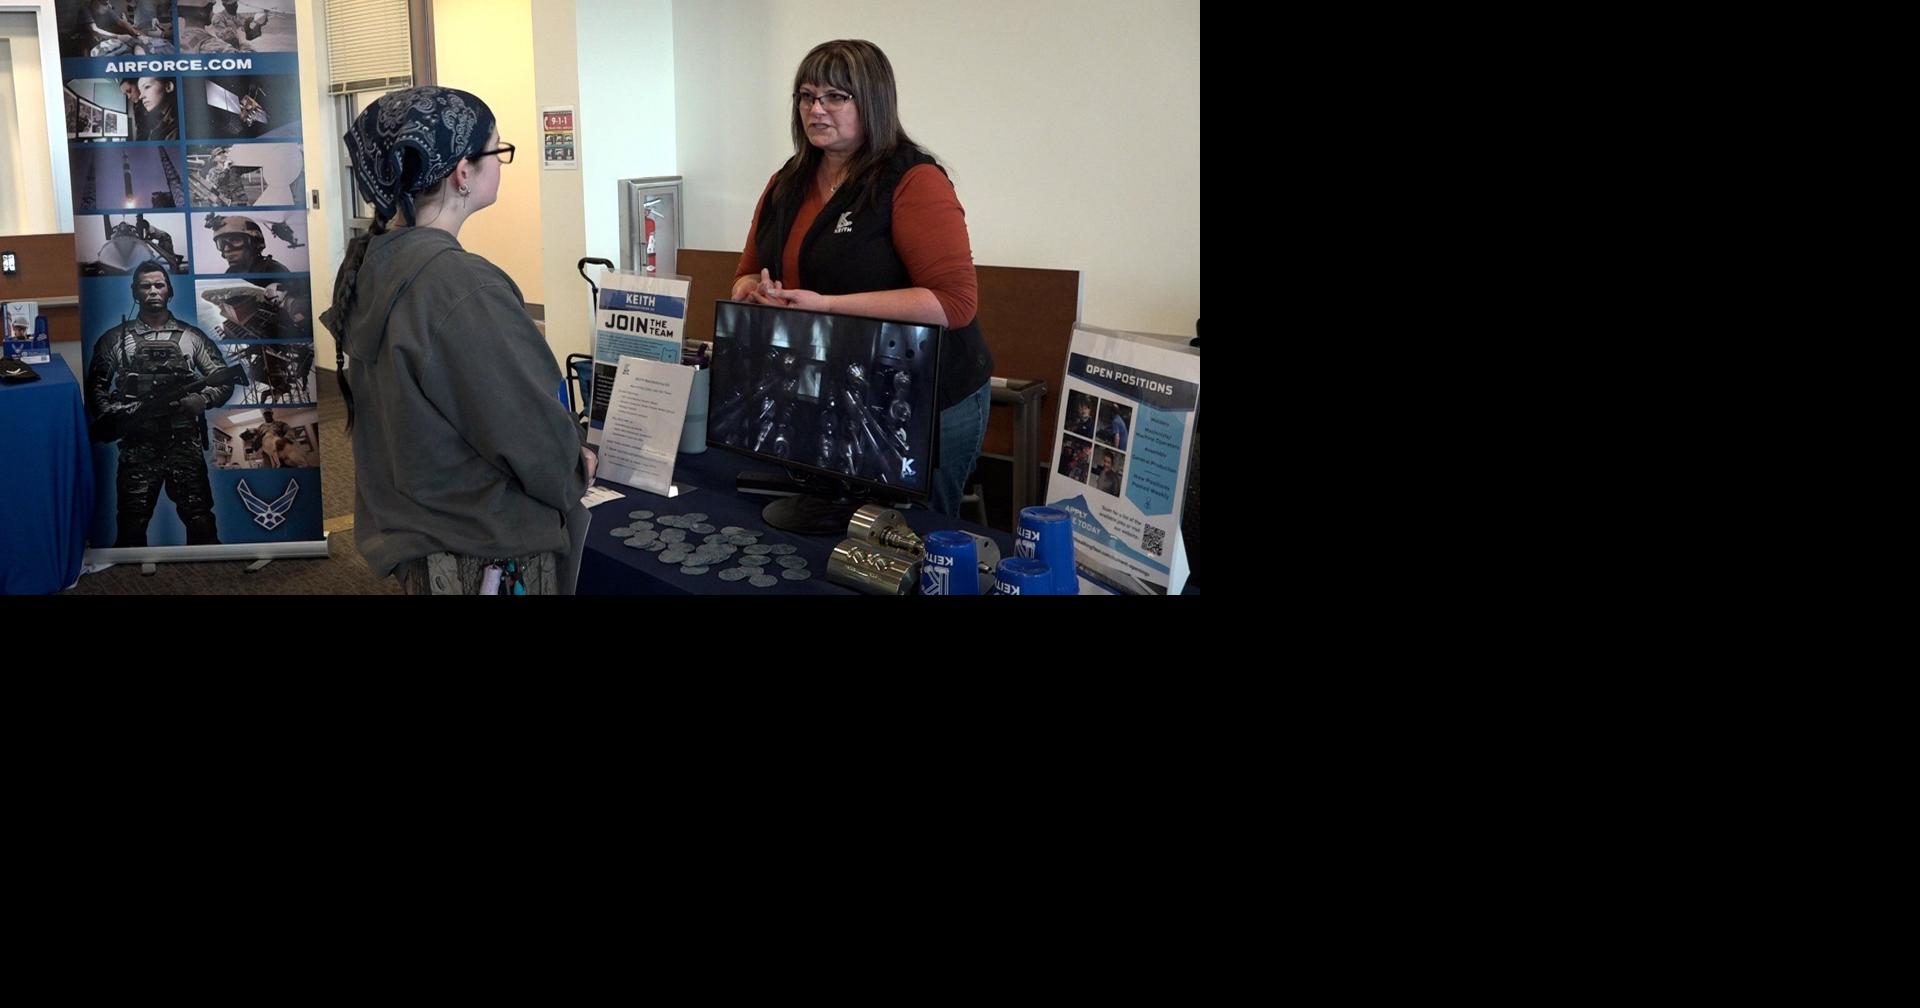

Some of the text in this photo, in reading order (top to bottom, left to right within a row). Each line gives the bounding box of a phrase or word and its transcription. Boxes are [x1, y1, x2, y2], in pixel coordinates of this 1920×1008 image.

[105, 58, 252, 73] AIRFORCE.COM
[551, 116, 567, 125] 9-1-1
[625, 293, 656, 307] KEITH
[605, 313, 668, 334] JOIN THE
[649, 327, 674, 338] TEAM
[1086, 364, 1173, 396] OPEN POSITIONS
[1065, 505, 1088, 519] APPLY
[1079, 519, 1101, 534] TODAY
